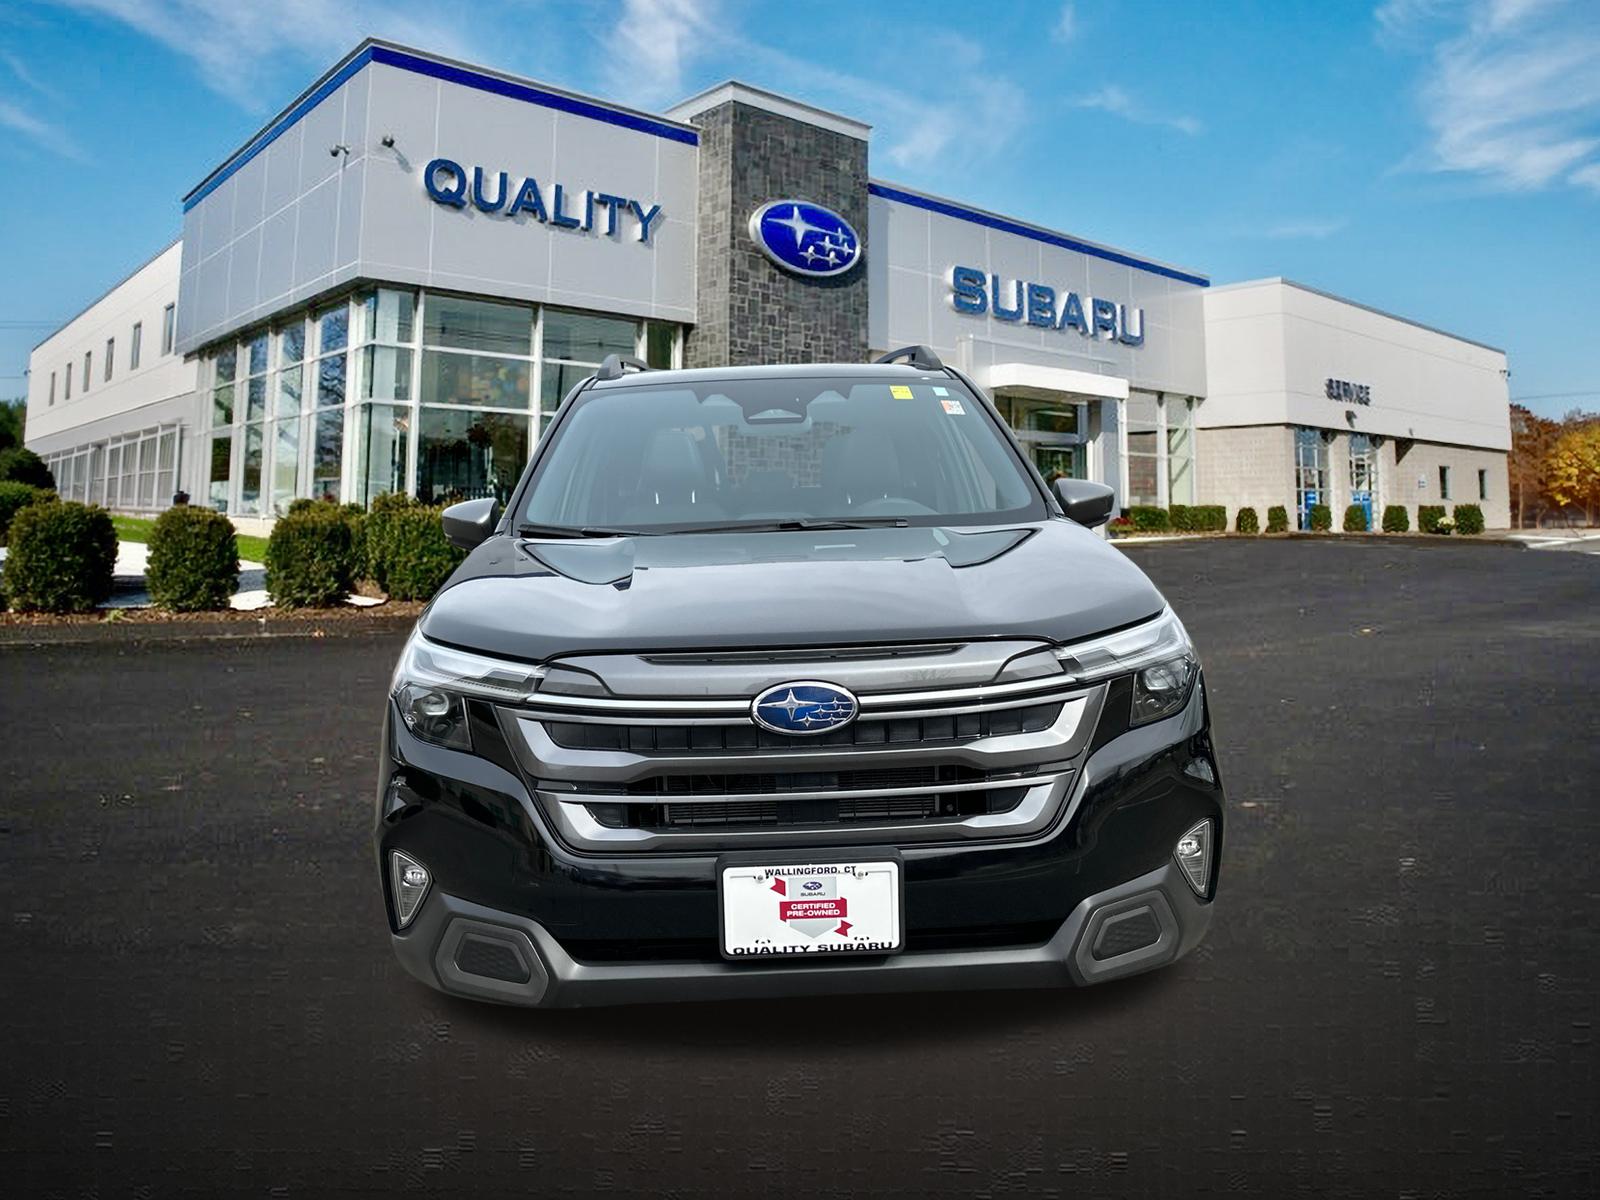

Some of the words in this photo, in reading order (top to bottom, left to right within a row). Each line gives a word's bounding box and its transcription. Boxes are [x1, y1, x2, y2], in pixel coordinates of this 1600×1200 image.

[424, 158, 661, 243] QUALITY
[952, 265, 1145, 347] SUBARU
[844, 866, 857, 874] CT
[733, 945, 810, 955] QUALITY
[817, 942, 892, 952] SUBARU
